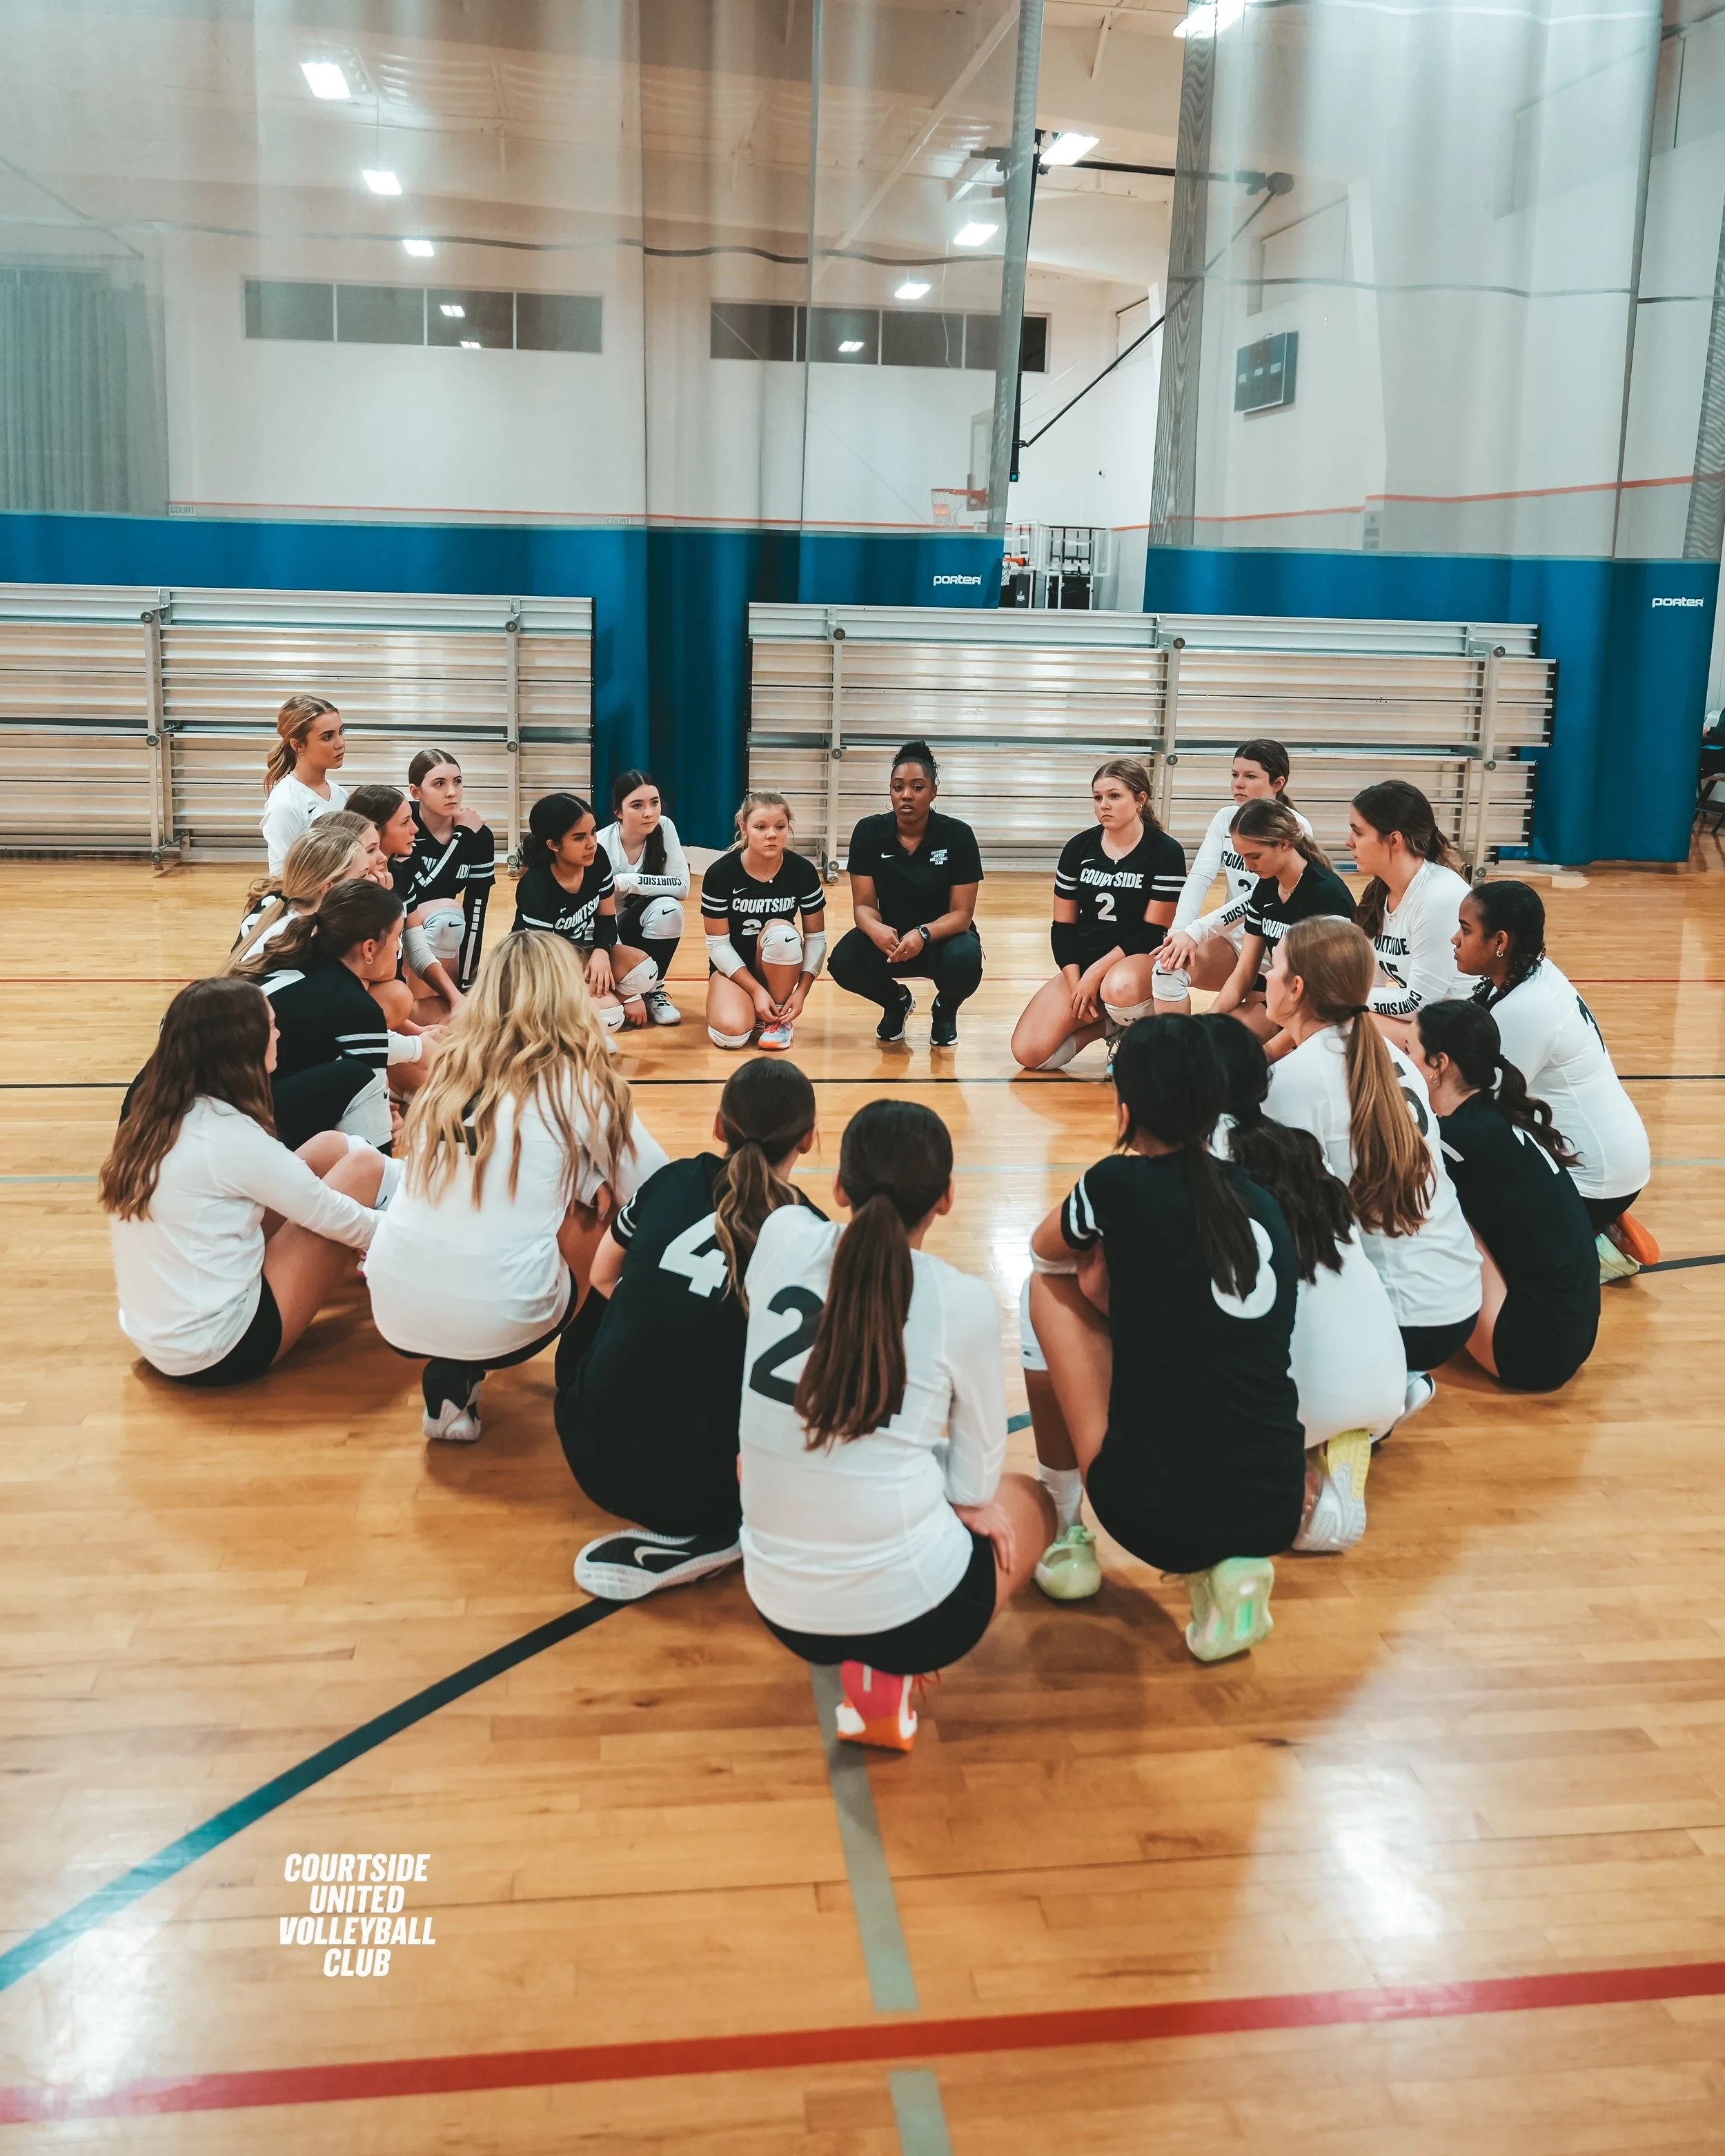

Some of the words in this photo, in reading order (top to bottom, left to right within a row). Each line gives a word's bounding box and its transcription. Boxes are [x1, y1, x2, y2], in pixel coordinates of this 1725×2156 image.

[554, 894, 600, 930] COURTSI
[732, 896, 797, 913] COURTSIDE
[1095, 892, 1117, 922] 2
[1221, 899, 1251, 927] TSIDE
[1262, 917, 1291, 939] COURT
